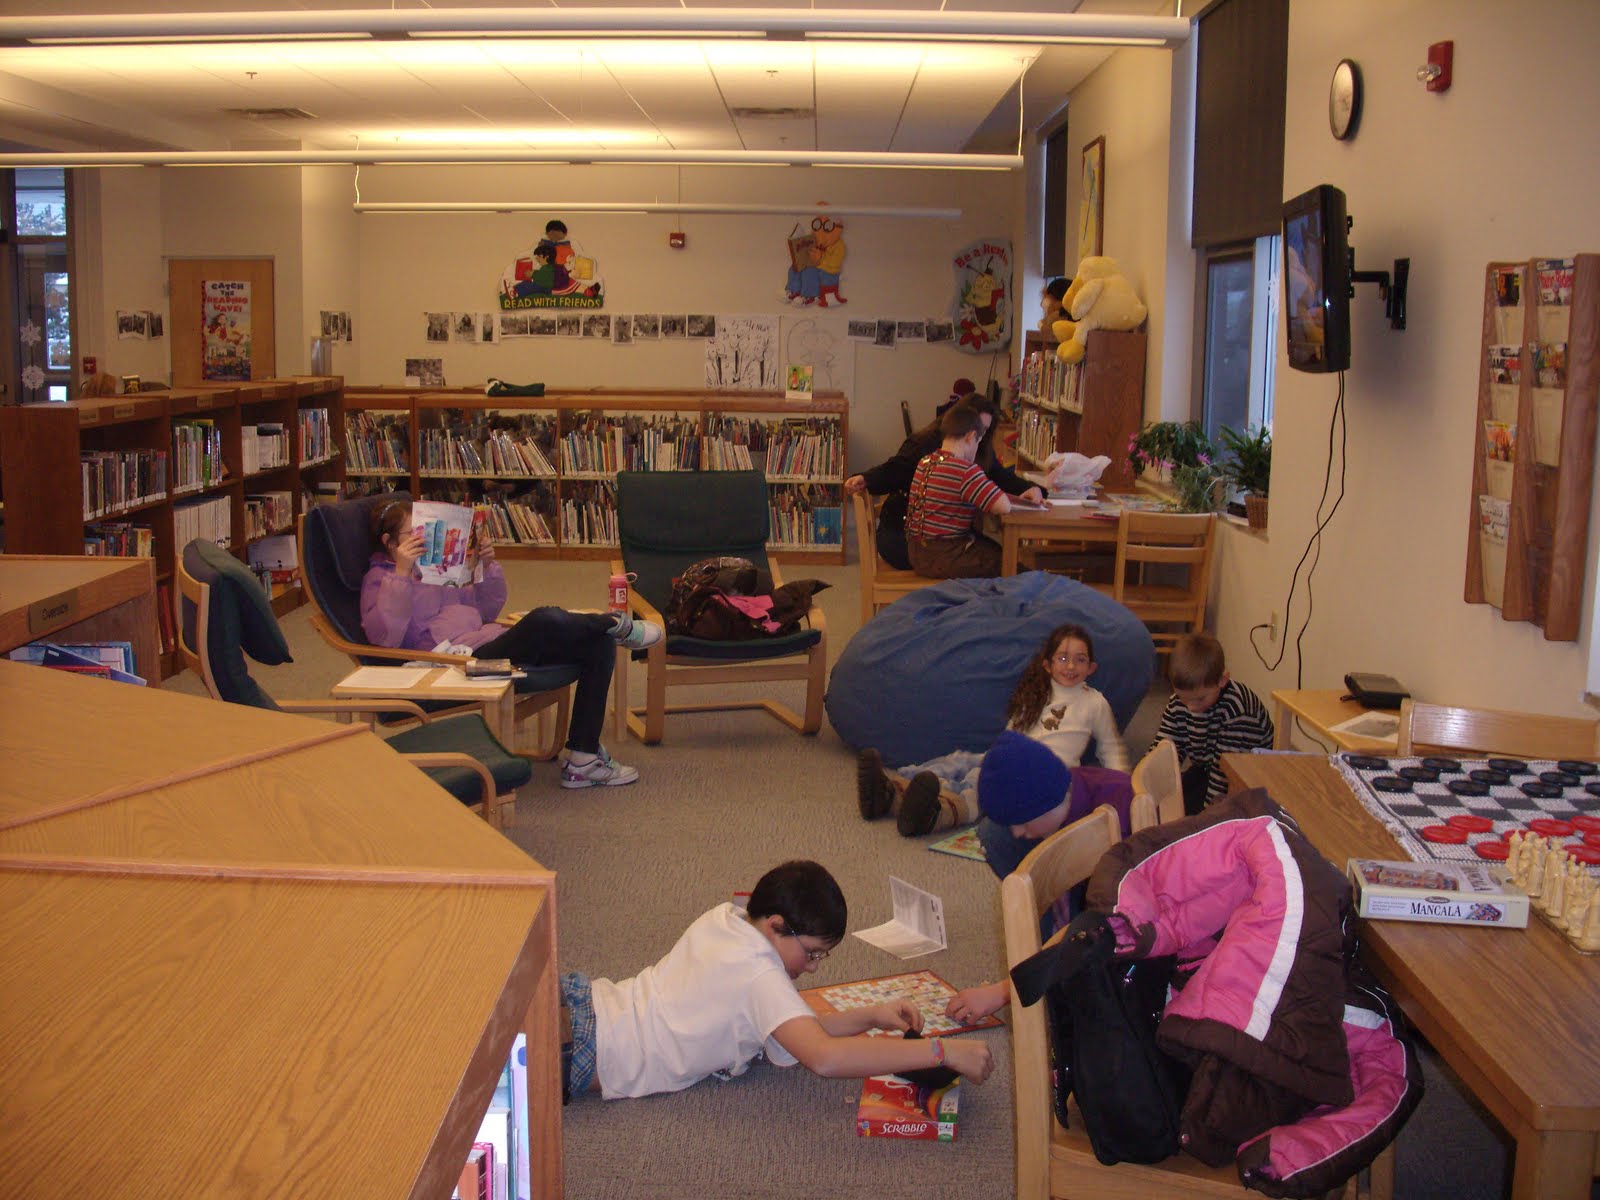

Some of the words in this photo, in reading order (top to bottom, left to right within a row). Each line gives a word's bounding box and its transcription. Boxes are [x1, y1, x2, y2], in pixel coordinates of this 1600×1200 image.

[211, 282, 244, 290] CATCH
[206, 296, 249, 305] READING
[503, 299, 532, 310] READ
[533, 297, 557, 308] WITH
[559, 297, 601, 309] FRIENDS
[213, 303, 243, 313] WAVE!
[1410, 902, 1462, 917] MANCALA
[881, 1121, 928, 1135] SCRABBLE
